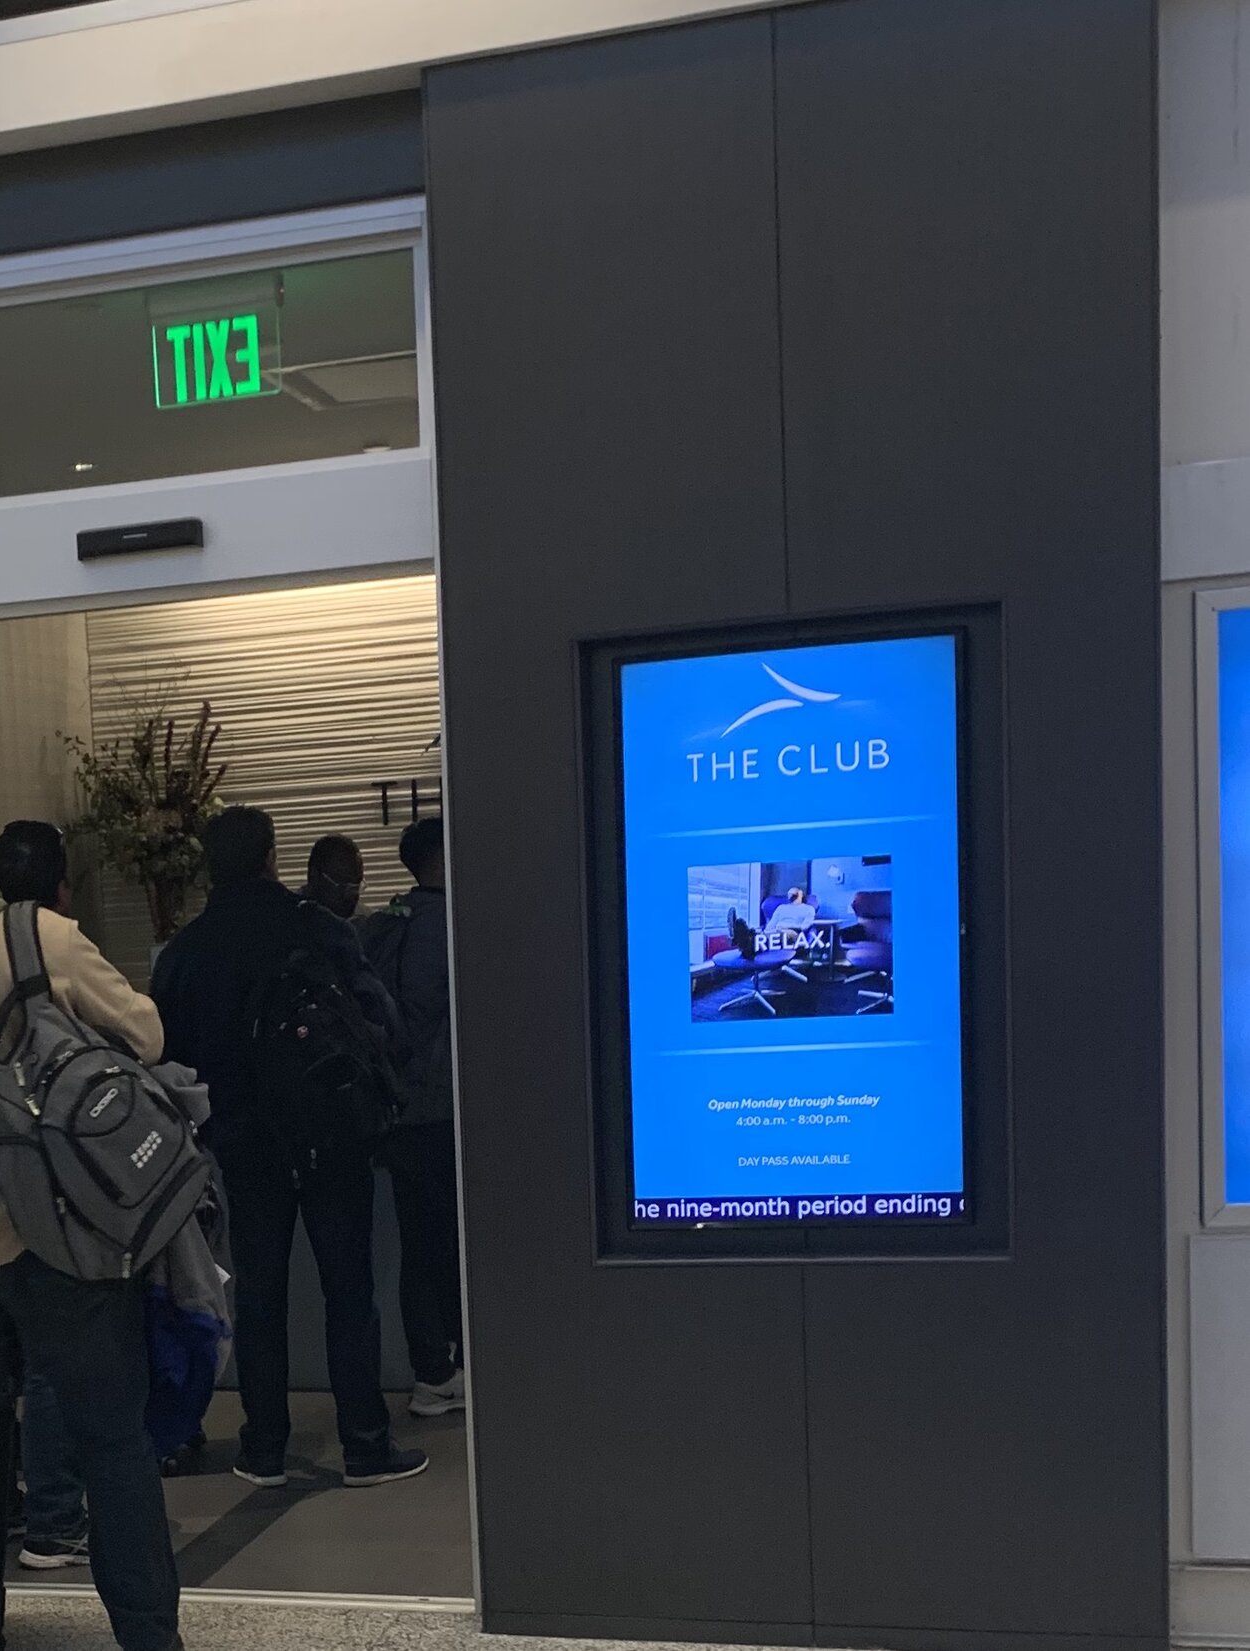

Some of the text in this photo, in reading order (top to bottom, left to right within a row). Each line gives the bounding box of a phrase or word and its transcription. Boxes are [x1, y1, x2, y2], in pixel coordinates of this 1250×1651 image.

[686, 738, 891, 783] THE CLUB
[370, 777, 442, 825] TH
[754, 929, 832, 953] RELAX.
[707, 1094, 880, 1112] Open Monday through Sunday
[736, 1116, 761, 1126] 4:00
[763, 1116, 788, 1126] a.m.
[798, 1114, 823, 1124] 8:00
[825, 1114, 851, 1126] p.m.
[738, 1154, 851, 1167] DAY PASS AVAILABLE
[634, 1199, 660, 1218] he
[666, 1197, 790, 1218] nine-month
[798, 1195, 867, 1219] period
[874, 1194, 952, 1217] ending
